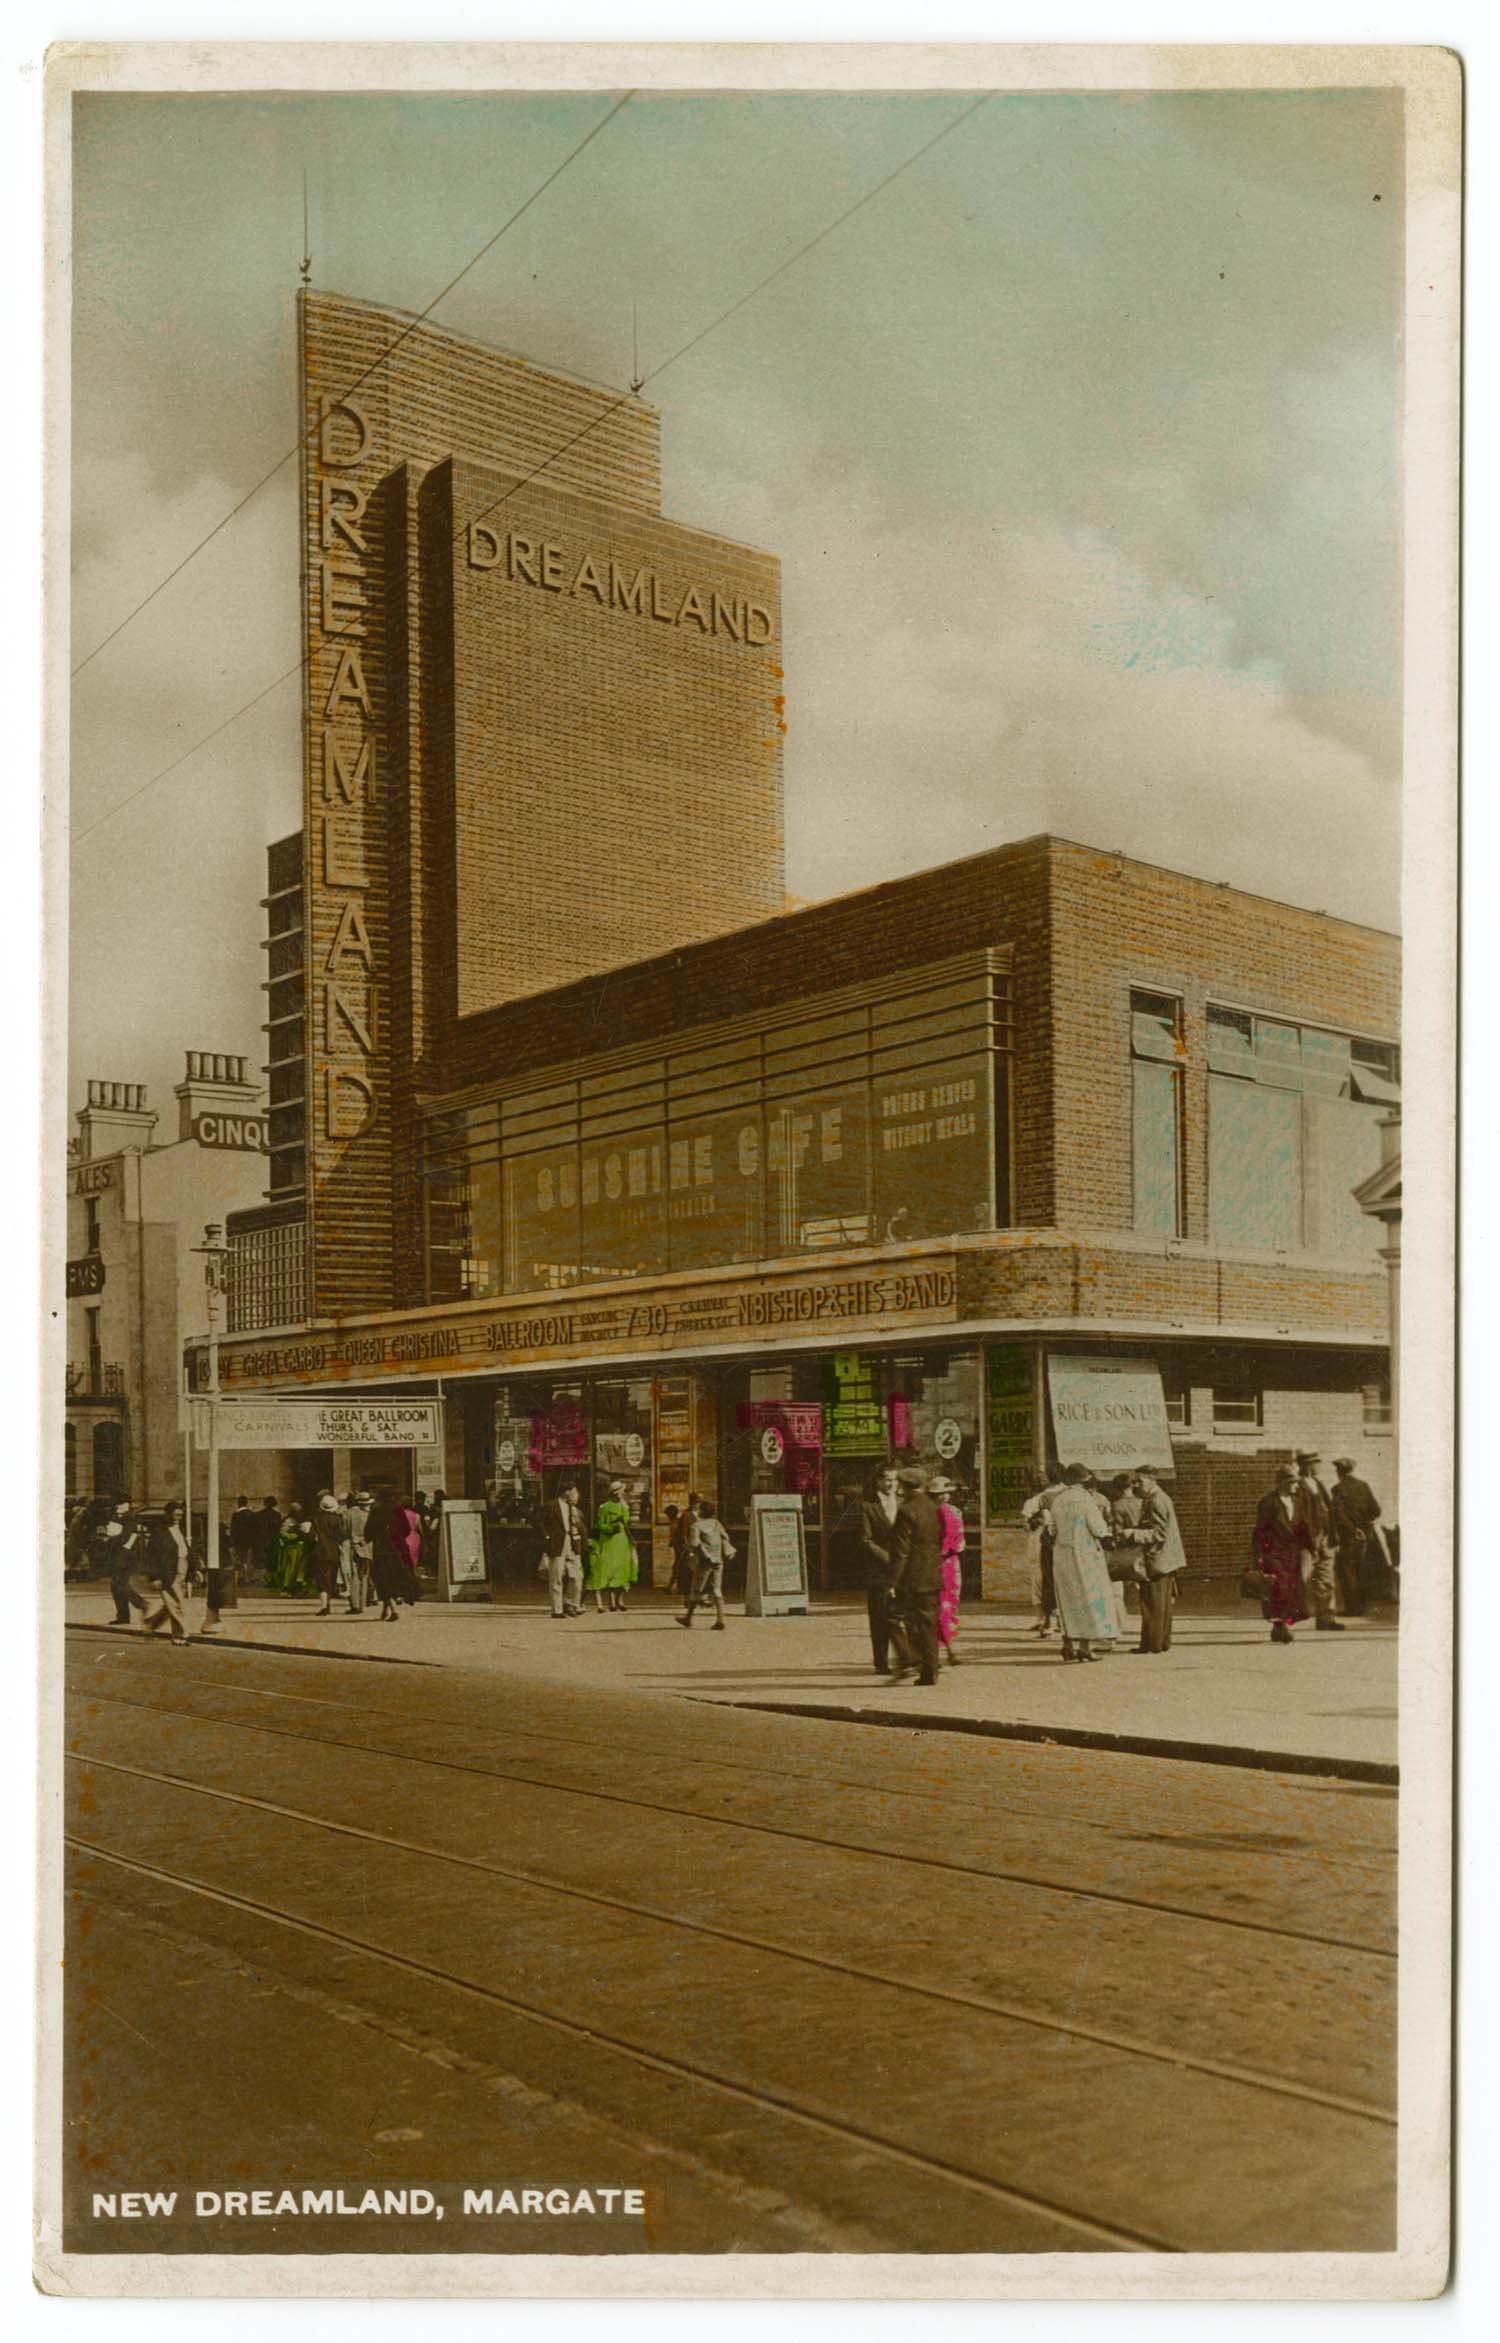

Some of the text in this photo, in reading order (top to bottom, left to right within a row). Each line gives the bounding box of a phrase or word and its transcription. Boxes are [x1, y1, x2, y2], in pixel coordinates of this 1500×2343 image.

[467, 521, 777, 646] DREAMLAND
[321, 396, 378, 1140] DREAMLAND
[537, 1107, 842, 1213] SUNSHINE CAFE
[895, 1271, 957, 1311] BAND
[343, 1328, 462, 1367] QUEEN CHRISTINA
[485, 1315, 573, 1353] BALLROOM
[242, 1350, 279, 1377] GRETA
[283, 1344, 326, 1371] GARBO
[330, 1409, 363, 1422] GREAT
[368, 1409, 428, 1422] BALLROOM
[1057, 1402, 1090, 1423] RICE
[1104, 1402, 1137, 1423] SON
[316, 1432, 377, 1441] WONDERFUL
[384, 1432, 415, 1441] BAND
[765, 1436, 776, 1452] 2
[942, 1429, 953, 1446] 2
